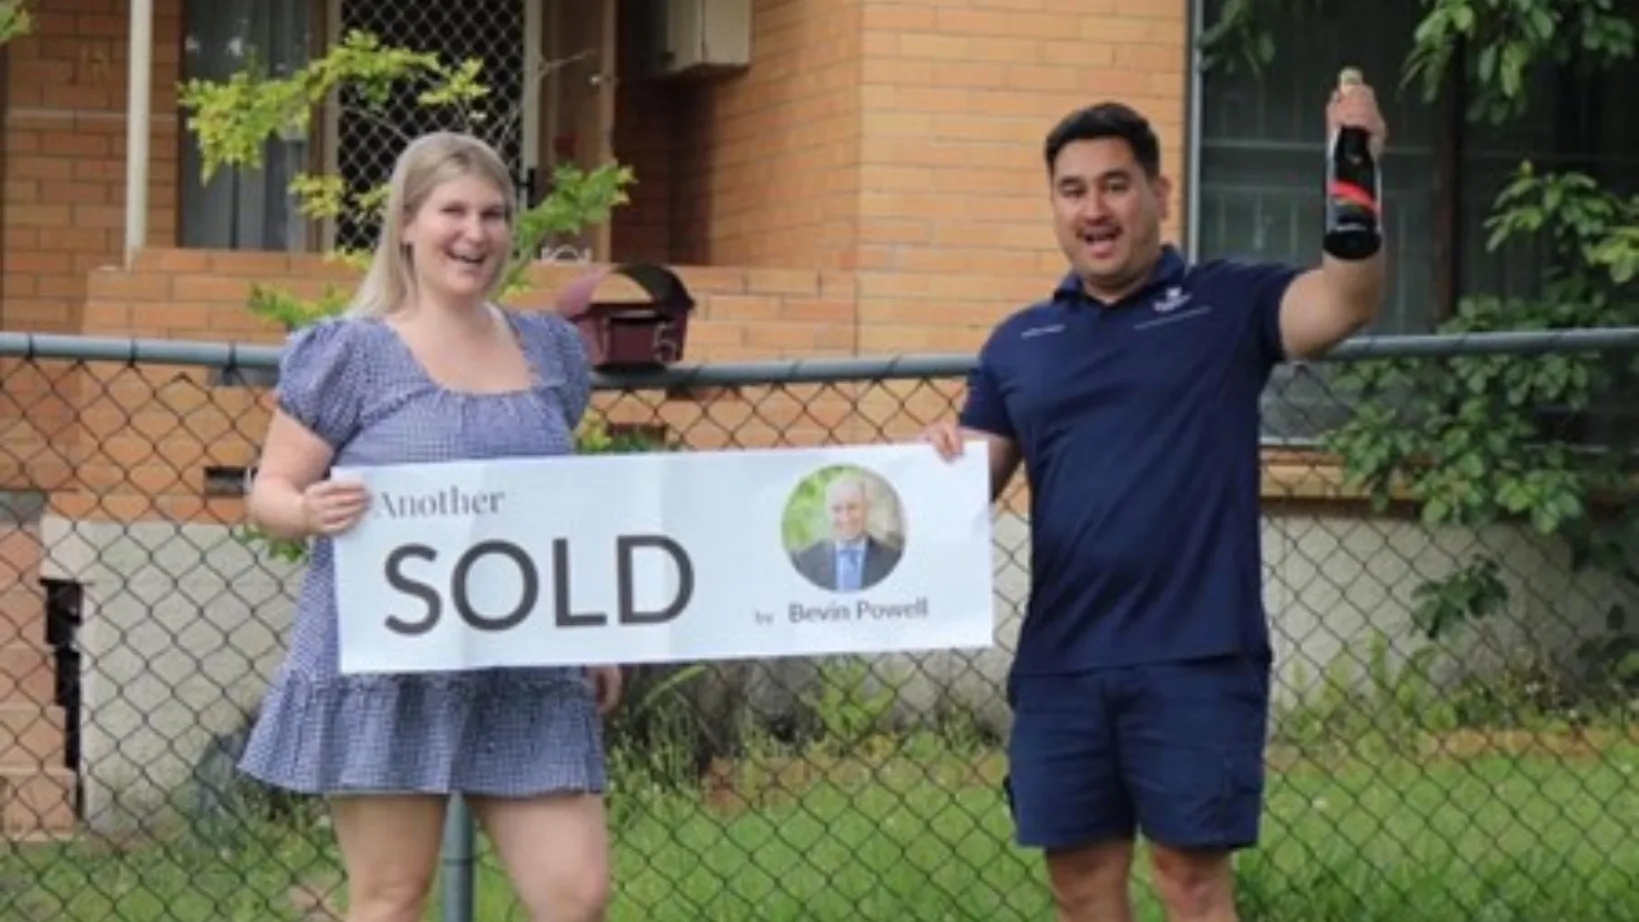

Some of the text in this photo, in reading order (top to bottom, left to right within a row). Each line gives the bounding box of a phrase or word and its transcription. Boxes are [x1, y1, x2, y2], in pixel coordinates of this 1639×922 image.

[375, 483, 506, 520] Another
[384, 534, 696, 637] SOLD
[788, 601, 850, 624] Bevin
[857, 596, 929, 621] Powell
